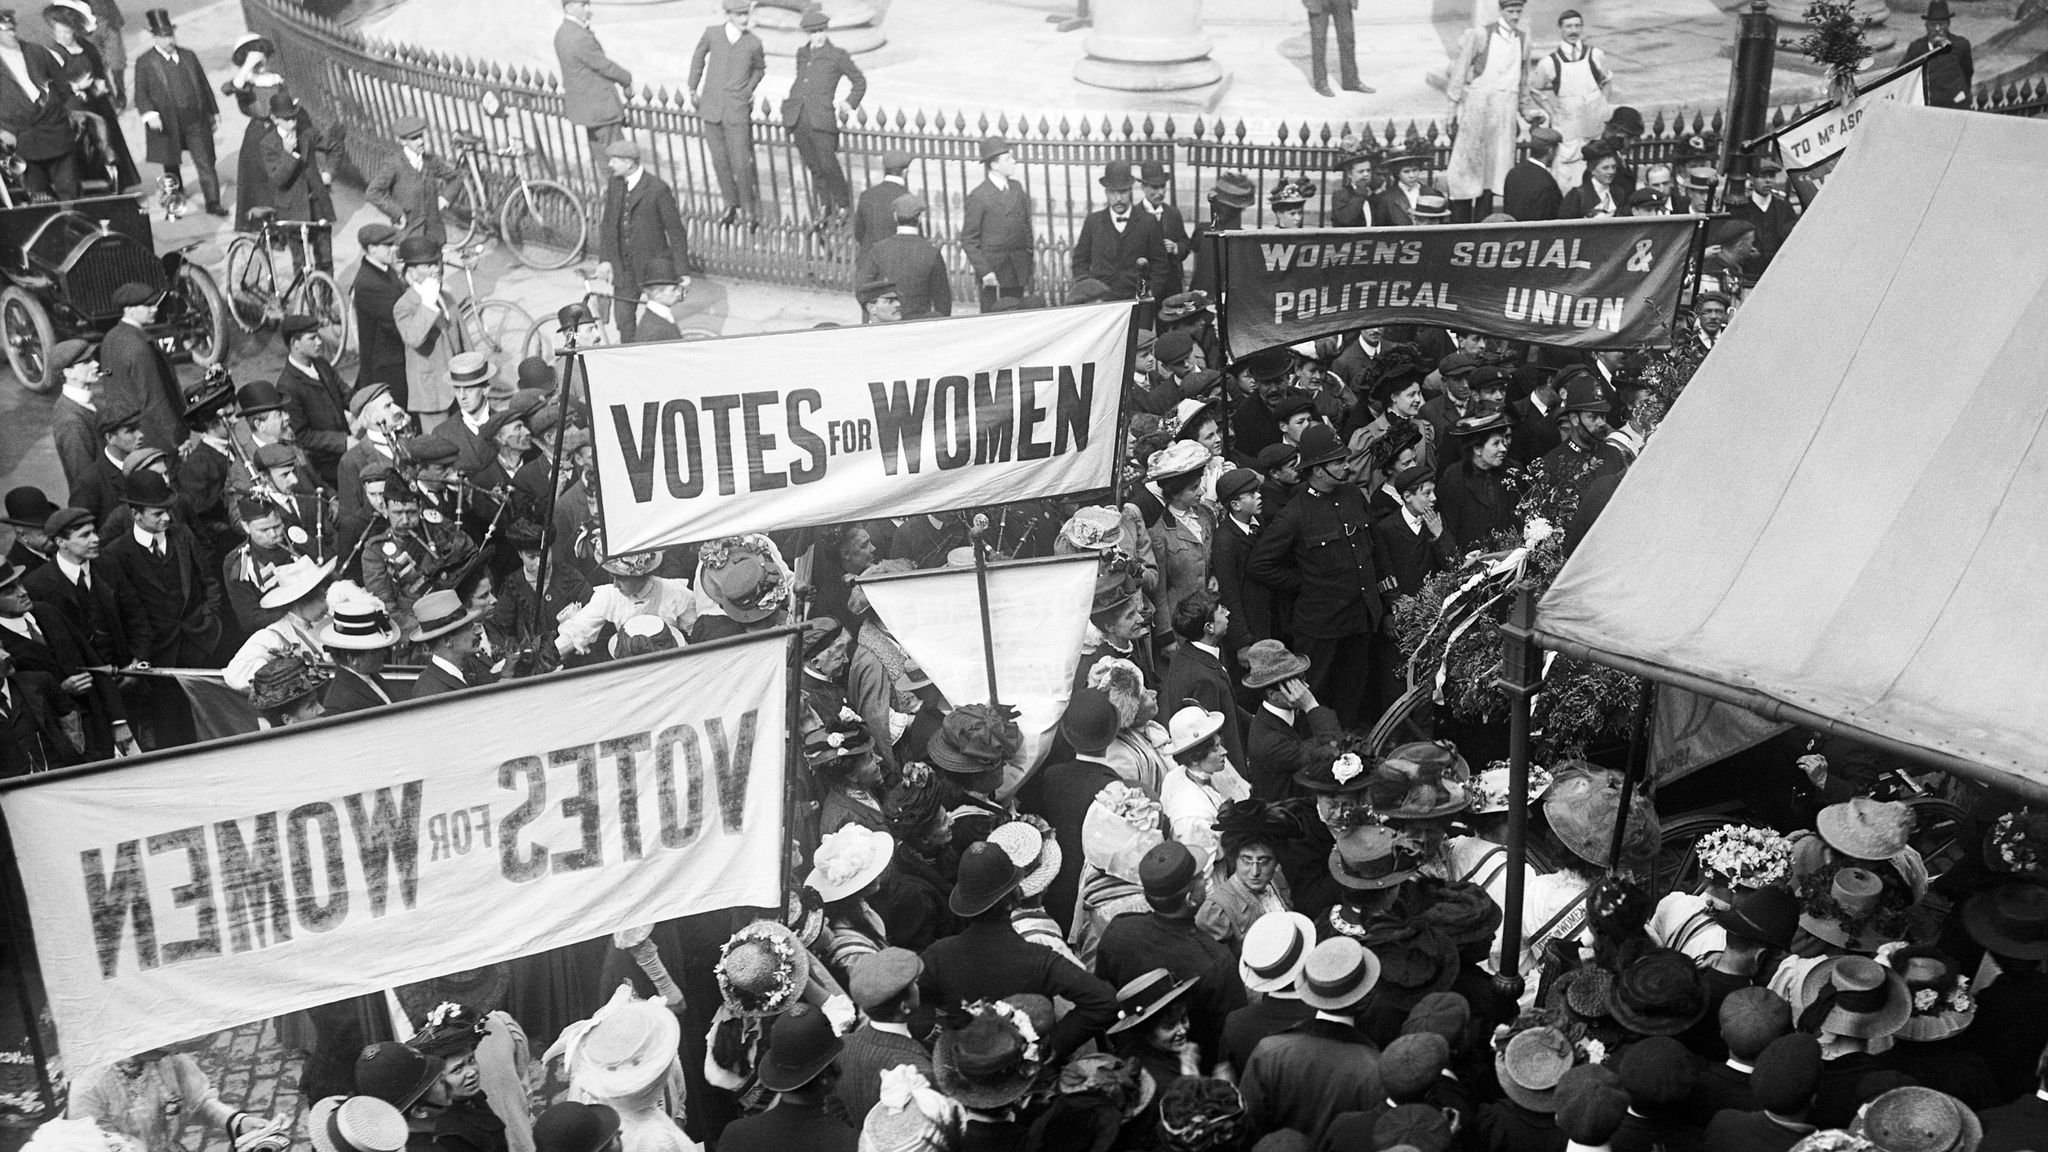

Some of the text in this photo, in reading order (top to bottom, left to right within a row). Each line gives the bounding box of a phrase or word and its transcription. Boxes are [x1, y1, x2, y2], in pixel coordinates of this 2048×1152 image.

[1791, 138, 1811, 158] TO
[1260, 238, 1653, 272] WOMEN'S SOCIAL &
[1275, 280, 1625, 333] POLITICAL UNION
[609, 362, 1095, 503] VOTES FOR WOMEN
